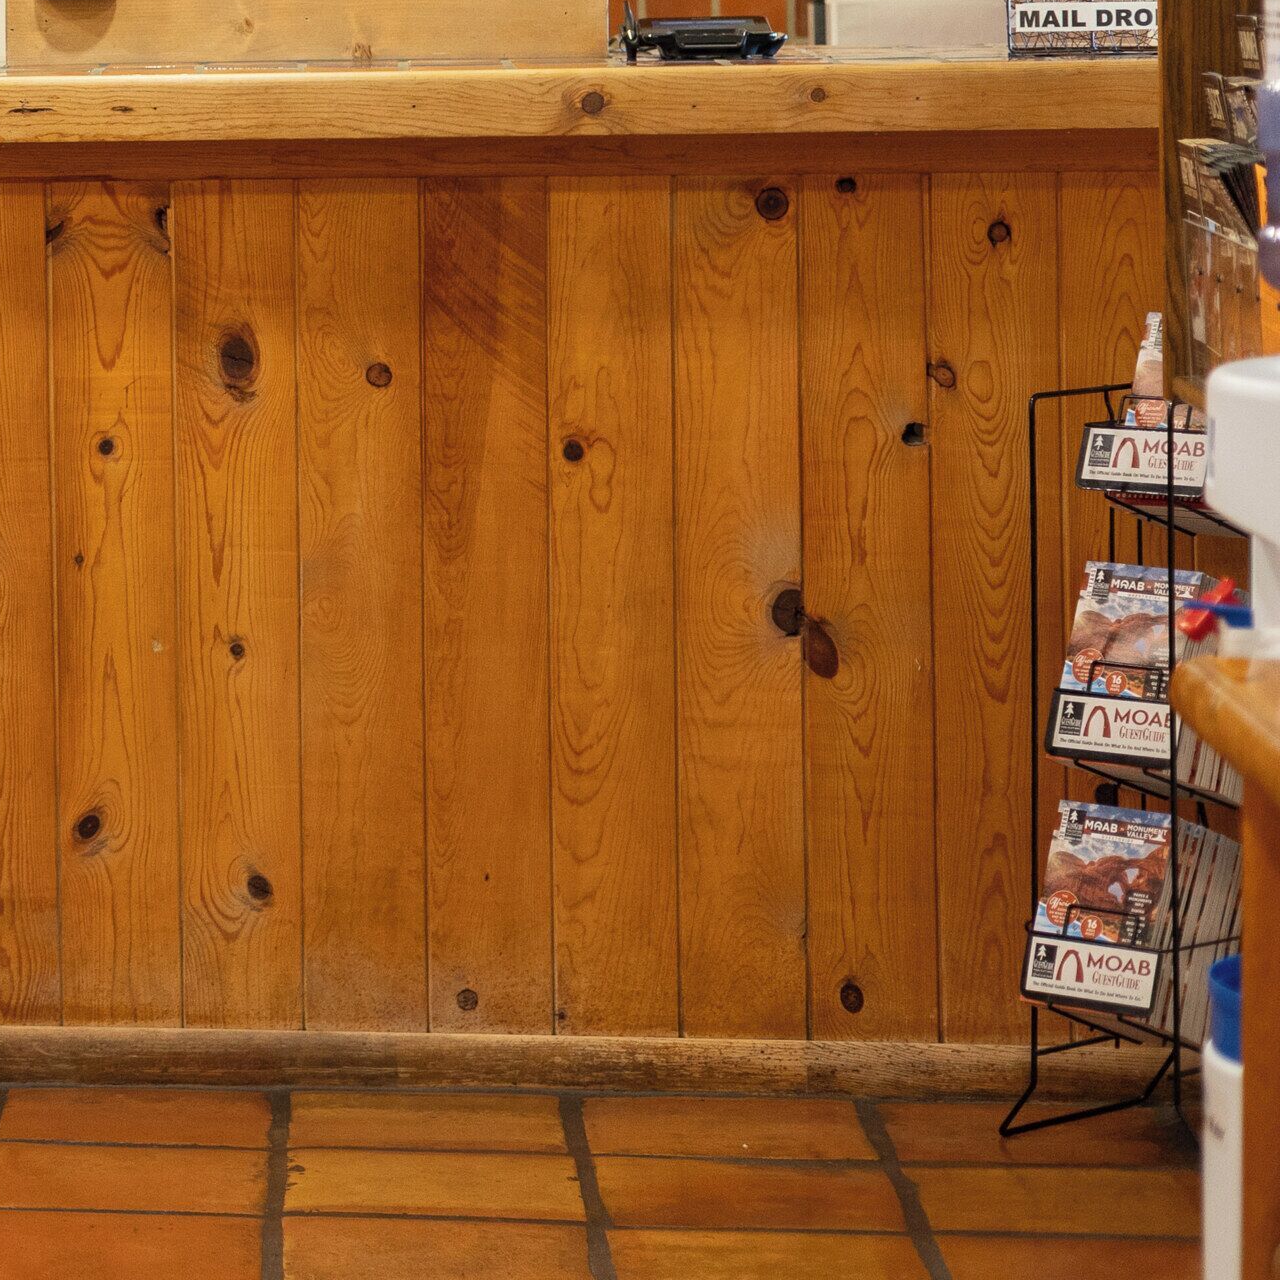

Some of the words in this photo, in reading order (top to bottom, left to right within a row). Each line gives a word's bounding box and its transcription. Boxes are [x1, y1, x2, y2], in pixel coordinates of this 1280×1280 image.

[1019, 9, 1087, 28] MAIL
[1096, 8, 1158, 28] DRO
[1142, 438, 1205, 457] MOAB
[1111, 579, 1145, 591] MOAB
[1111, 675, 1122, 685] 16
[1085, 820, 1118, 833] MOAB
[1127, 825, 1169, 836] MONUMENT
[1127, 831, 1153, 840] VALLEY
[1087, 920, 1098, 929] 16
[1086, 952, 1151, 976] MOAB
